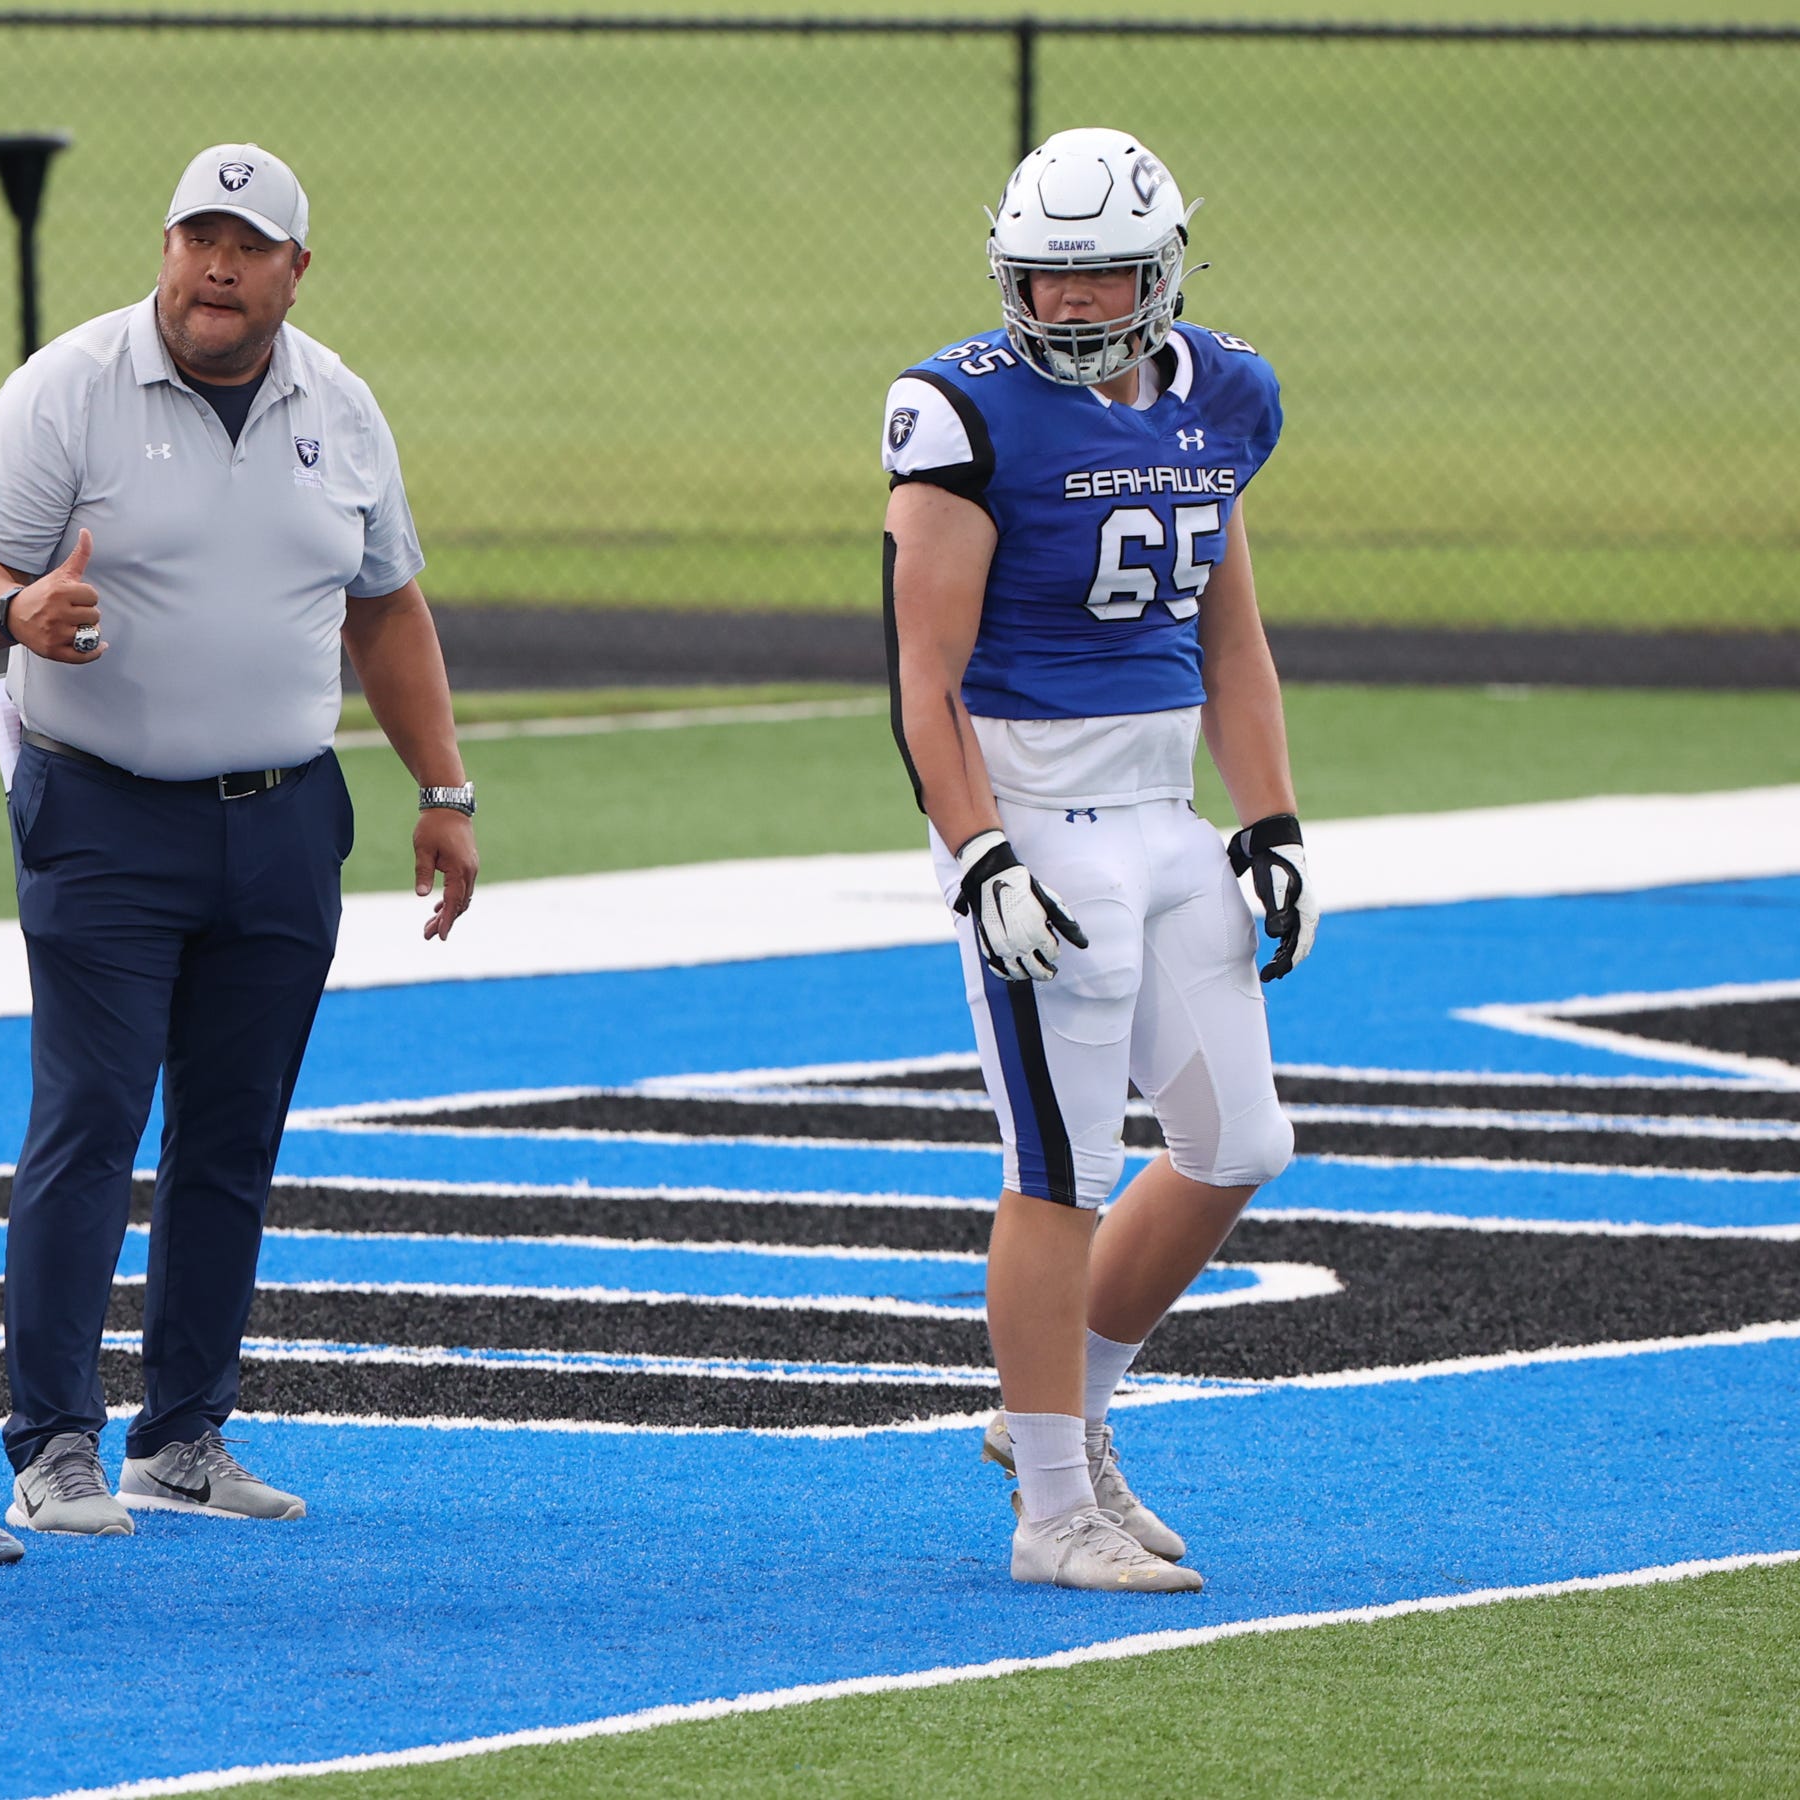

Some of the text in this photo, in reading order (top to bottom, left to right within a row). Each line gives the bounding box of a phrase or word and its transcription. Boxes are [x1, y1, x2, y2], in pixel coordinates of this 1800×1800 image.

[1048, 240, 1095, 251] SEAHAWKS
[934, 341, 1020, 378] 65
[1070, 357, 1096, 365] Rddell
[1063, 466, 1236, 500] SEAHAWKS
[1082, 499, 1222, 623] 65
